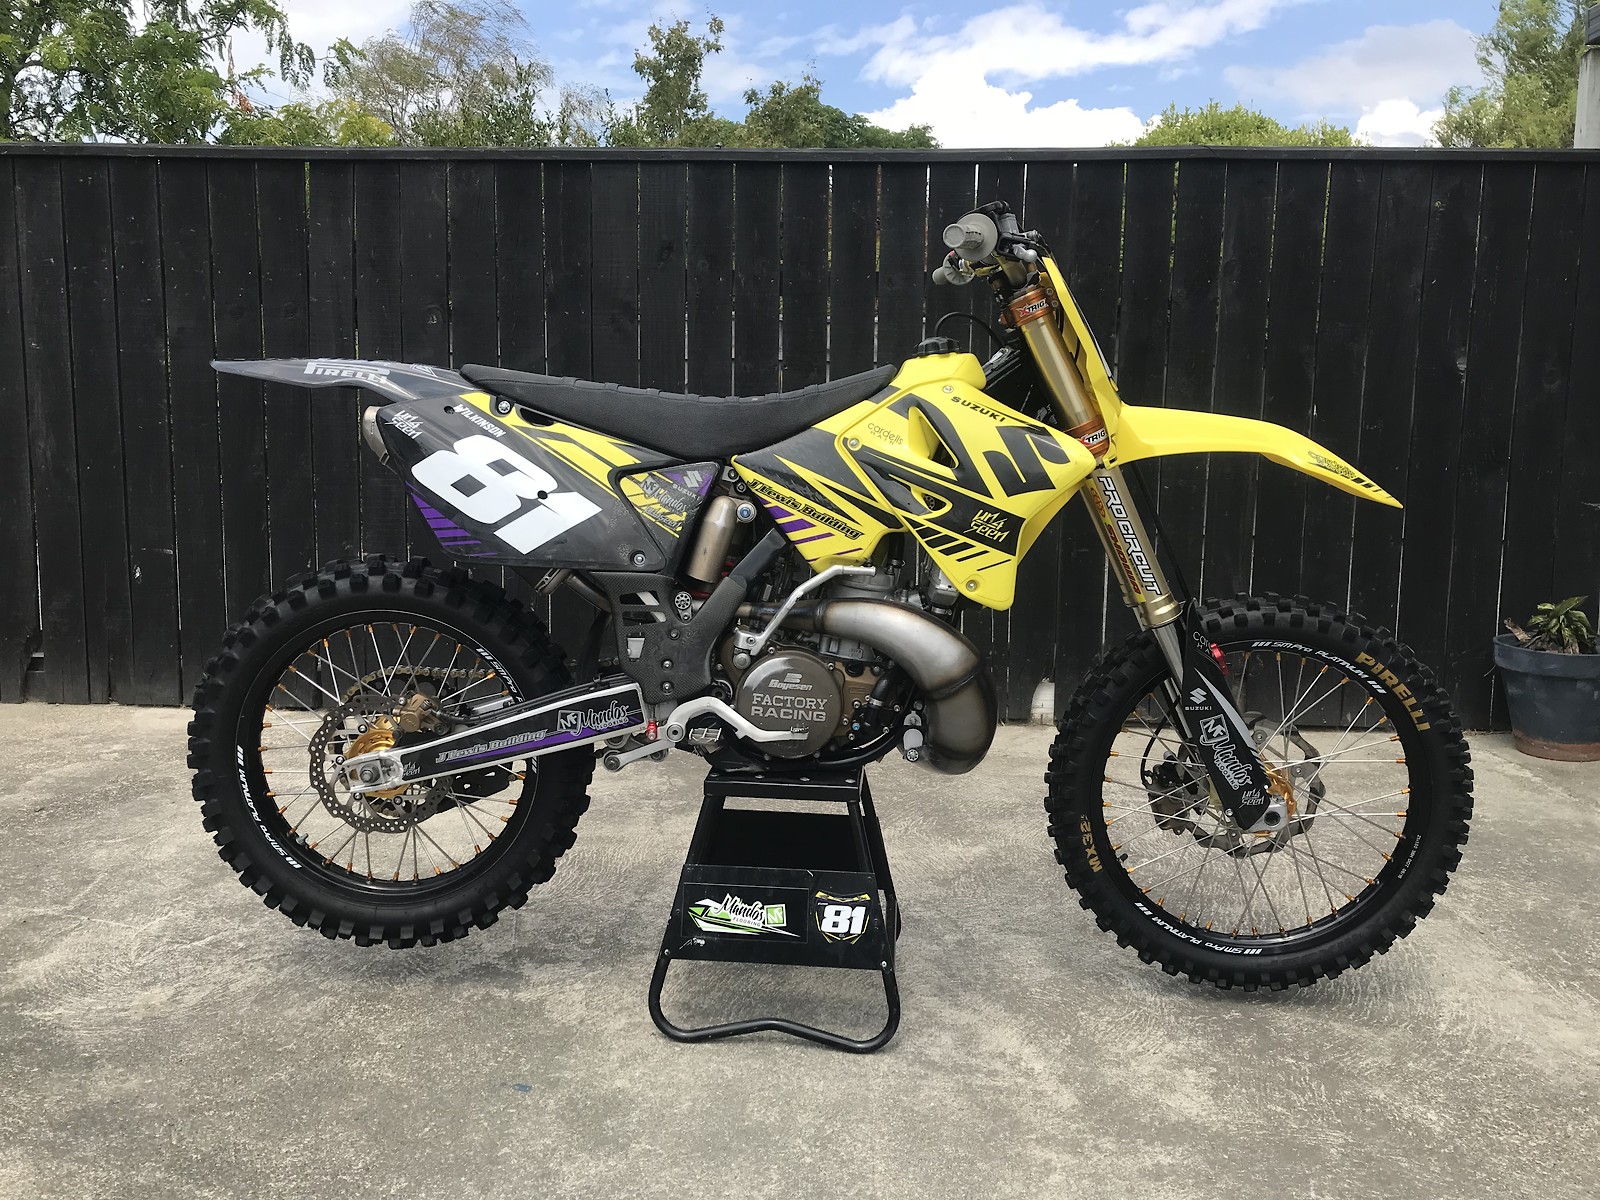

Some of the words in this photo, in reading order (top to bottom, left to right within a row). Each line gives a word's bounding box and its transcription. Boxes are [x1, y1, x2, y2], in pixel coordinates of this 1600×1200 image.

[303, 361, 390, 385] PIRELLI
[453, 403, 507, 438] WILKINSON
[950, 395, 1006, 423] SUZUKI
[411, 434, 603, 556] 81
[672, 483, 701, 501] SUZUKI
[800, 503, 865, 540] Building
[1096, 475, 1128, 519] PRO
[1117, 519, 1163, 596] CIRCUIT
[1314, 650, 1370, 679] PLATINUM
[767, 679, 813, 691] Boyesen
[1354, 651, 1432, 732] PIRELLI
[750, 705, 827, 723] RACING
[751, 692, 828, 710] FACTORY
[570, 699, 630, 737] Mandos
[1200, 735, 1253, 786] Mandos
[237, 768, 262, 822] PLATINUM
[714, 892, 765, 922] Mandos
[732, 916, 761, 927] FLOORING
[820, 904, 867, 935] 81
[1151, 916, 1203, 946] PLATINUM
